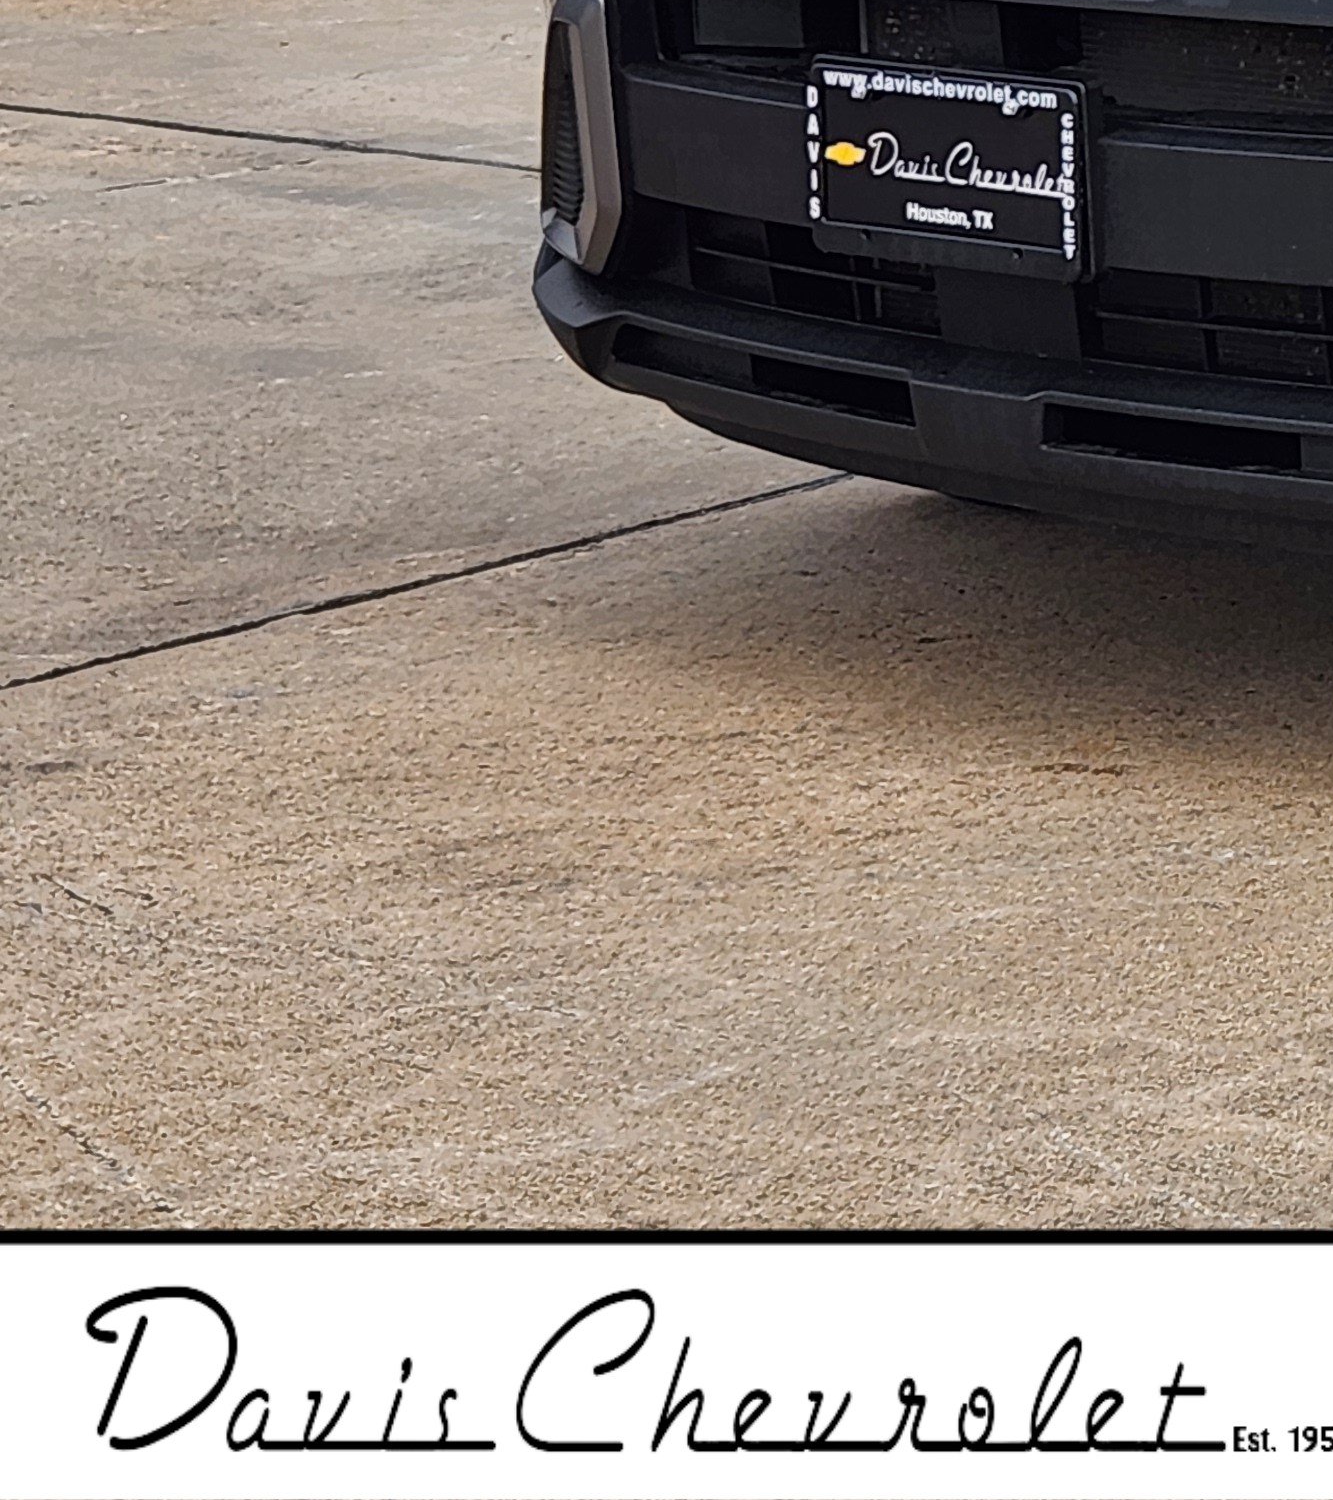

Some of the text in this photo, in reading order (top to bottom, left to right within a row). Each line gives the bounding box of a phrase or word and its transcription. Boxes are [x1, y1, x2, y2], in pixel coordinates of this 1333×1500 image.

[822, 70, 1058, 110] www.davischevrolet.com
[806, 85, 821, 220] DAVIS
[867, 131, 946, 183] Davis
[1060, 112, 1076, 260] CHEVROLET
[906, 202, 994, 230] Houston, TX
